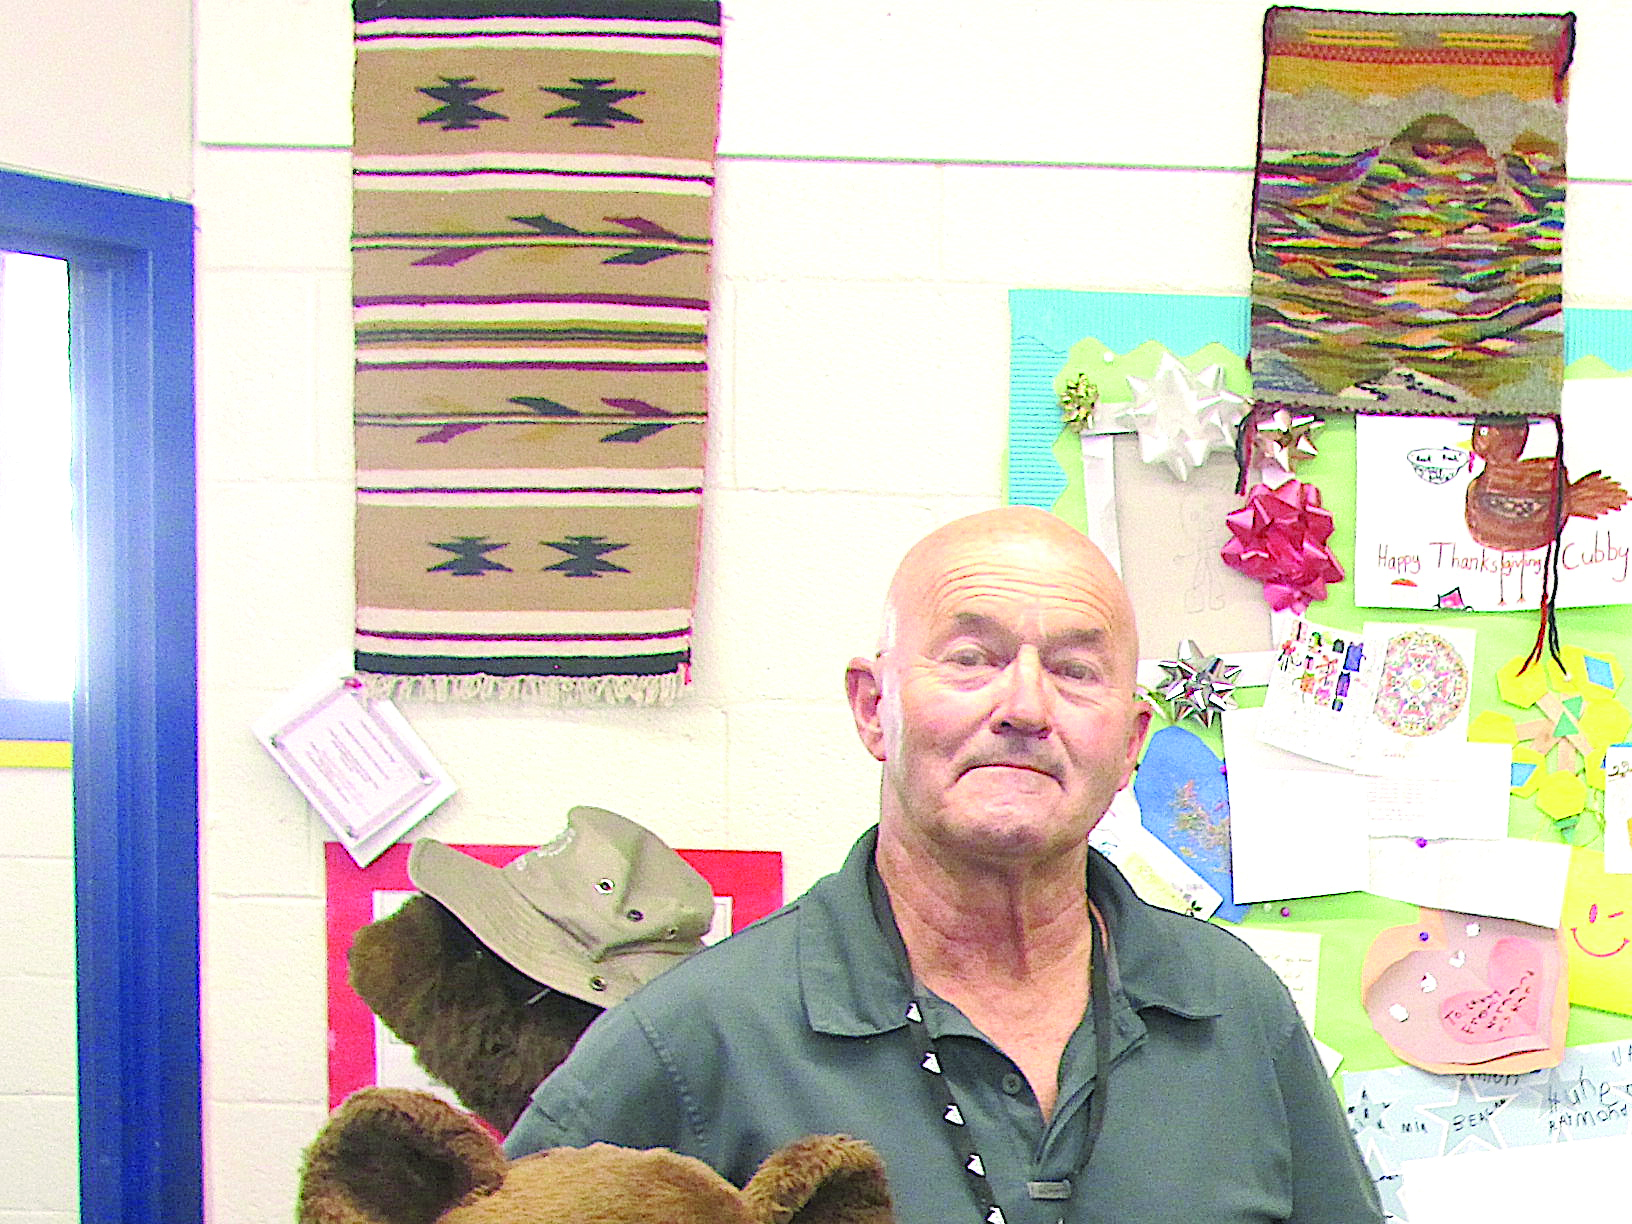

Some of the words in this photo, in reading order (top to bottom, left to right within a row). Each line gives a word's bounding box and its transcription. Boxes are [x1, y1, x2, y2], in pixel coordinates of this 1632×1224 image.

[1378, 543, 1421, 574] Happy
[1429, 541, 1543, 577] Thanksgiving
[1562, 530, 1630, 582] Cubby
